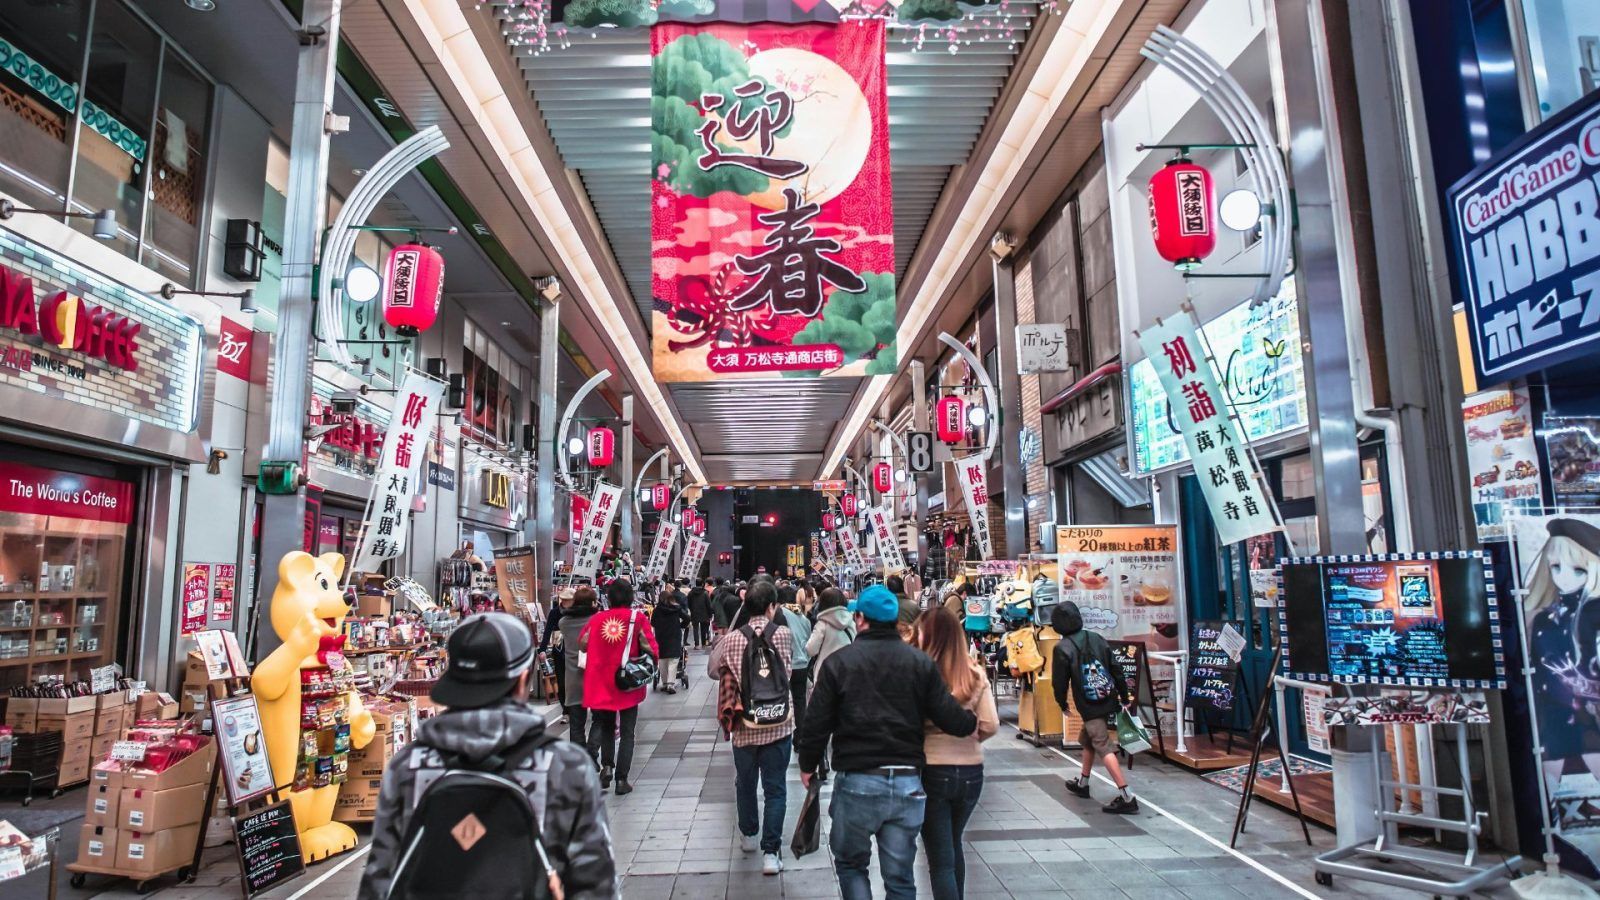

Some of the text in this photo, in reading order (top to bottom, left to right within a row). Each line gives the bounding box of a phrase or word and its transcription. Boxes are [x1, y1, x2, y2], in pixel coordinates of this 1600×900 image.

[695, 79, 867, 317] 迎春
[1466, 149, 1577, 228] CardGame
[1470, 171, 1600, 309] HOBB
[39, 290, 141, 371] COFFEE
[712, 350, 838, 368] 大須 万松寺通商店街
[1023, 331, 1064, 358] ポルテ
[33, 353, 64, 373] SINCE
[1161, 335, 1217, 424] 初詣
[911, 433, 931, 471] 8
[1195, 431, 1241, 521] 萬松寺
[1216, 424, 1260, 517] 大須観音
[10, 479, 118, 509] The World's Coffee
[1060, 528, 1103, 539] こだわりの
[1079, 537, 1171, 552] 20種類以上の紅茶
